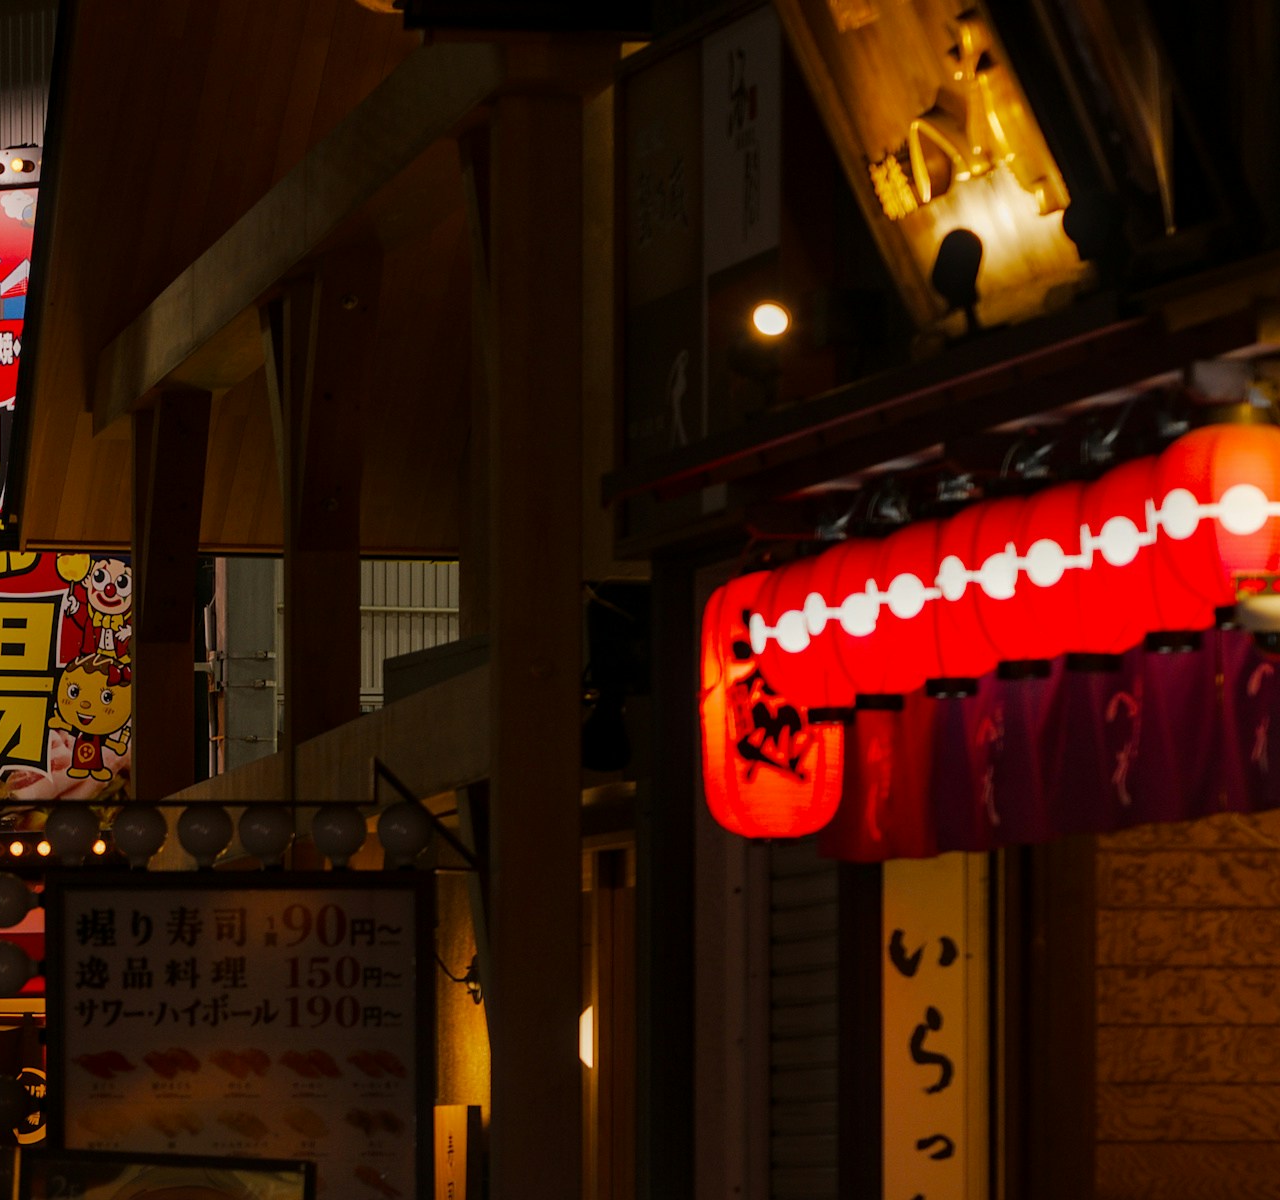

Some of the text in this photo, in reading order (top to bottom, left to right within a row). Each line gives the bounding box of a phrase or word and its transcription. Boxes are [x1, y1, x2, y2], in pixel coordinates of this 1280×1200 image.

[77, 908, 248, 948] 握り寿司
[76, 956, 248, 990] 逸品料理
[75, 992, 278, 1028] サワー・ハイボール
